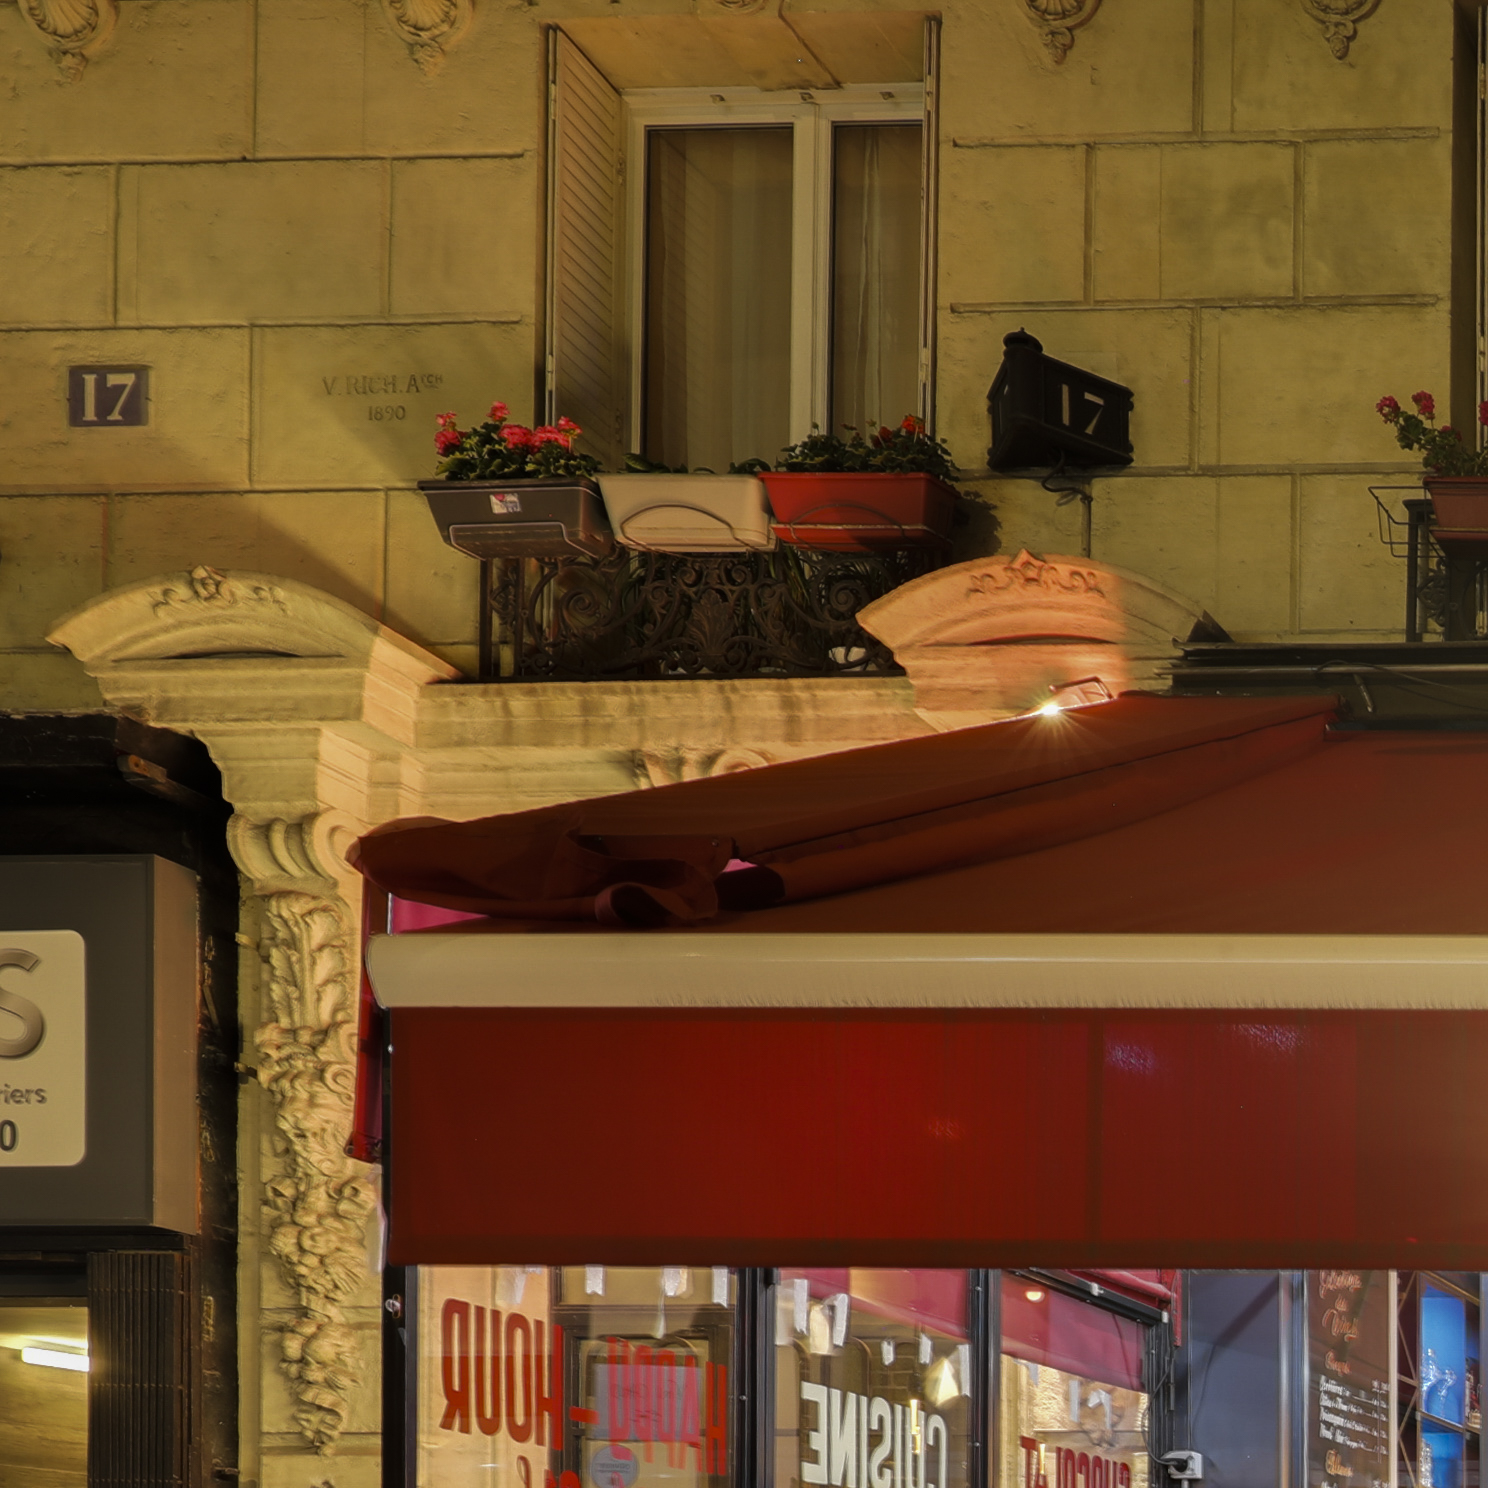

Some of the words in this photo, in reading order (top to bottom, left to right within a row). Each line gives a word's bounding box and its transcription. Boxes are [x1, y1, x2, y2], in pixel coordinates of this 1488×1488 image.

[82, 373, 136, 421] 17
[368, 405, 406, 421] 1890
[1059, 385, 1104, 434] 17
